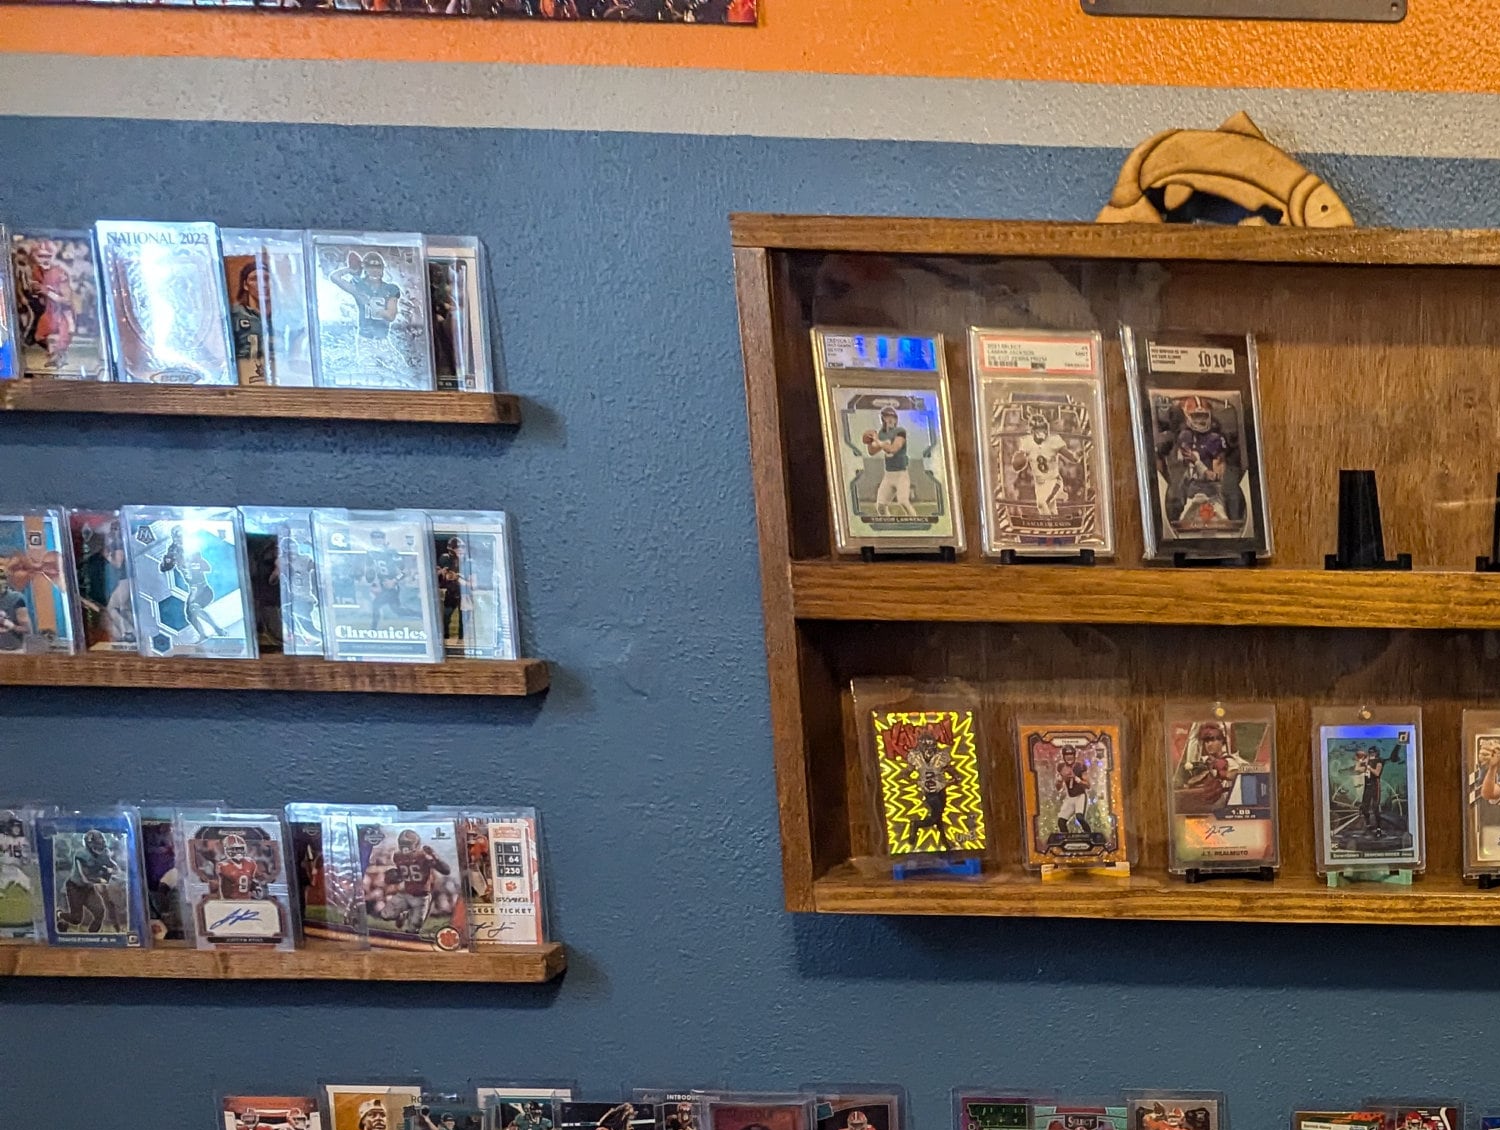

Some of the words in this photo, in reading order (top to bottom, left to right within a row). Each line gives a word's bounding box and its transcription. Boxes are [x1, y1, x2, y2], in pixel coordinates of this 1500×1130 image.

[106, 231, 175, 245] NATIONAL
[180, 233, 209, 245] 2023
[335, 624, 428, 641] Chronicles
[238, 875, 249, 893] 9
[1067, 1115, 1096, 1128] SELECT
